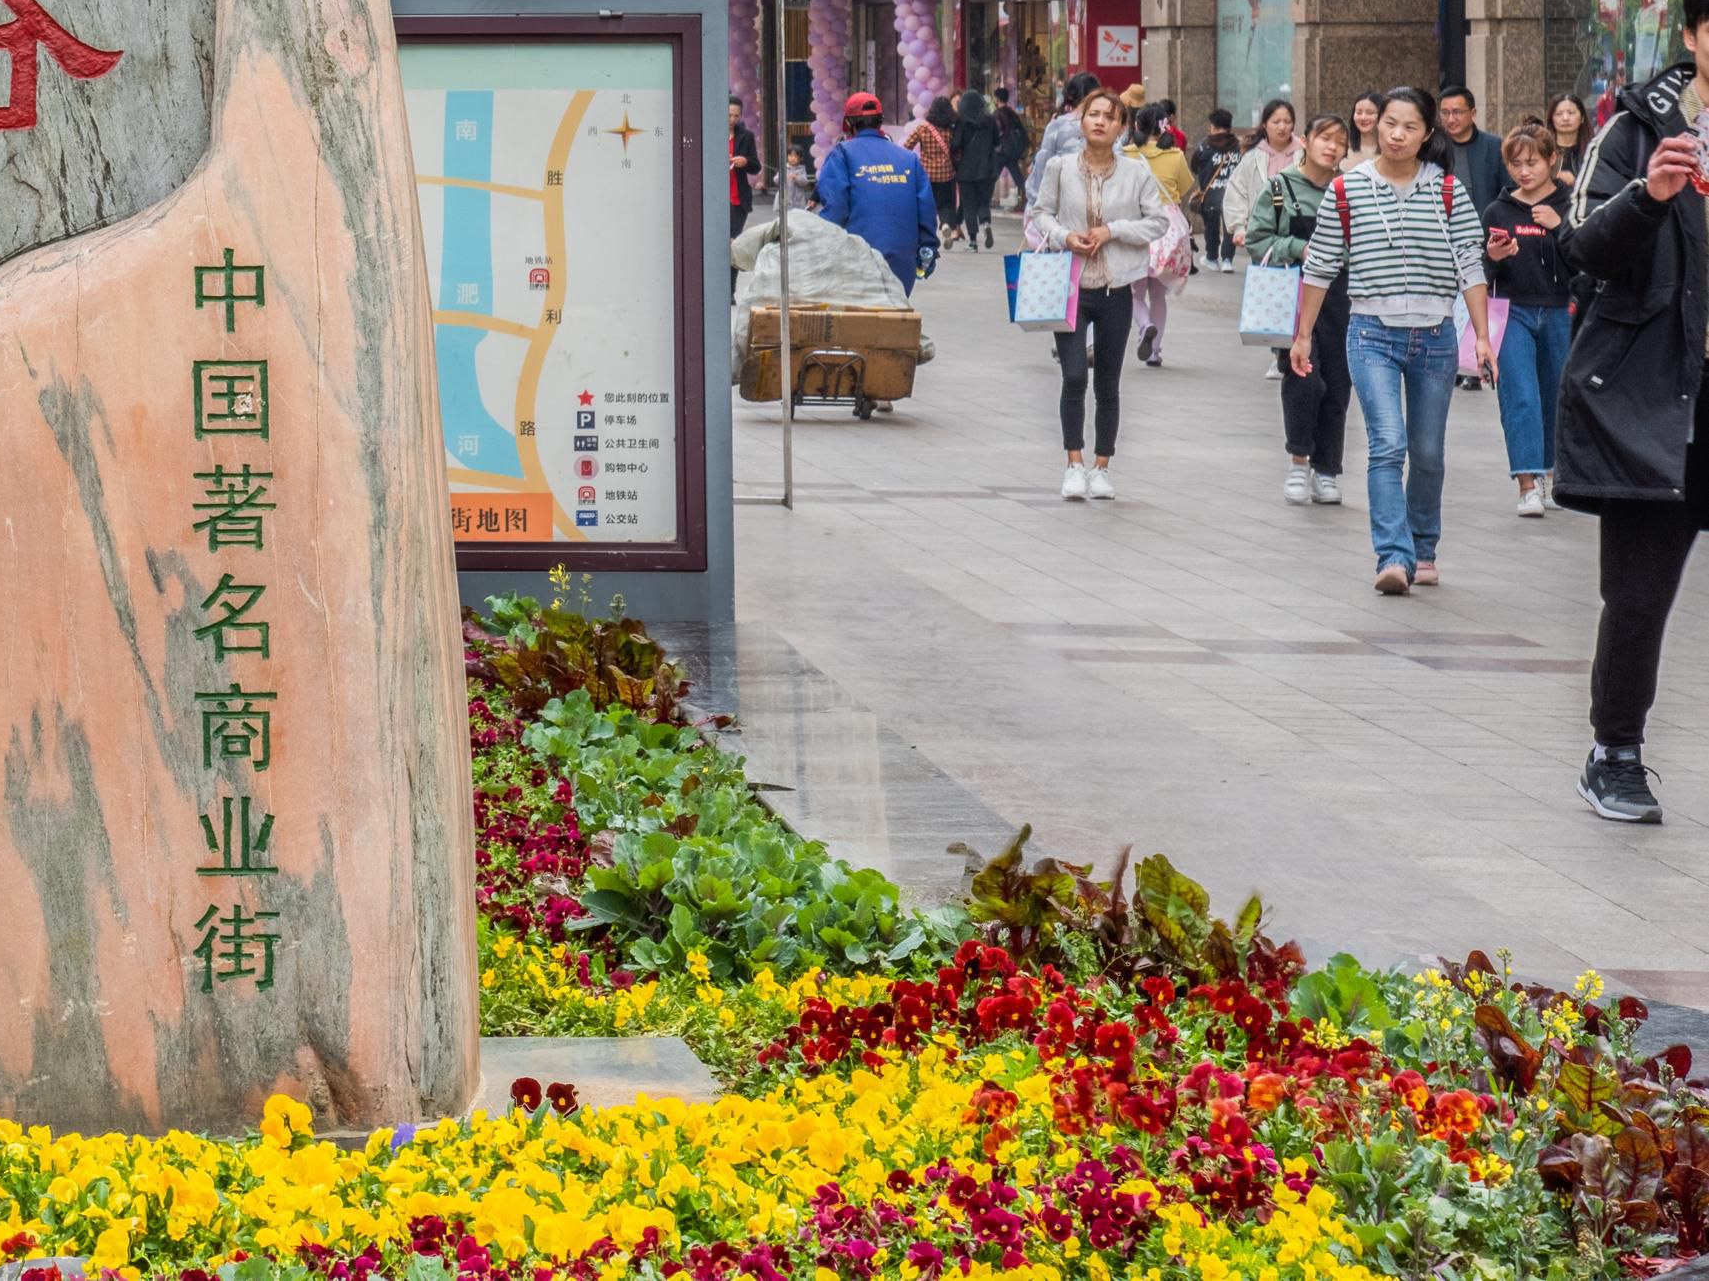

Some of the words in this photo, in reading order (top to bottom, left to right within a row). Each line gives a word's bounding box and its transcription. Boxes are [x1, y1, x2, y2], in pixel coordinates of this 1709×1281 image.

[621, 94, 631, 104] 北
[654, 127, 664, 137] 东
[525, 256, 553, 265] 地铁站
[604, 393, 670, 404] 您此刻的位置
[604, 415, 637, 425] 停车场
[605, 438, 660, 449] 公共卫生间
[605, 462, 648, 473] 购物中心
[605, 490, 638, 501] 地铁站
[452, 507, 528, 534] 街地图
[605, 514, 638, 525] 公交站
[193, 247, 280, 993] 中国著名商业街
